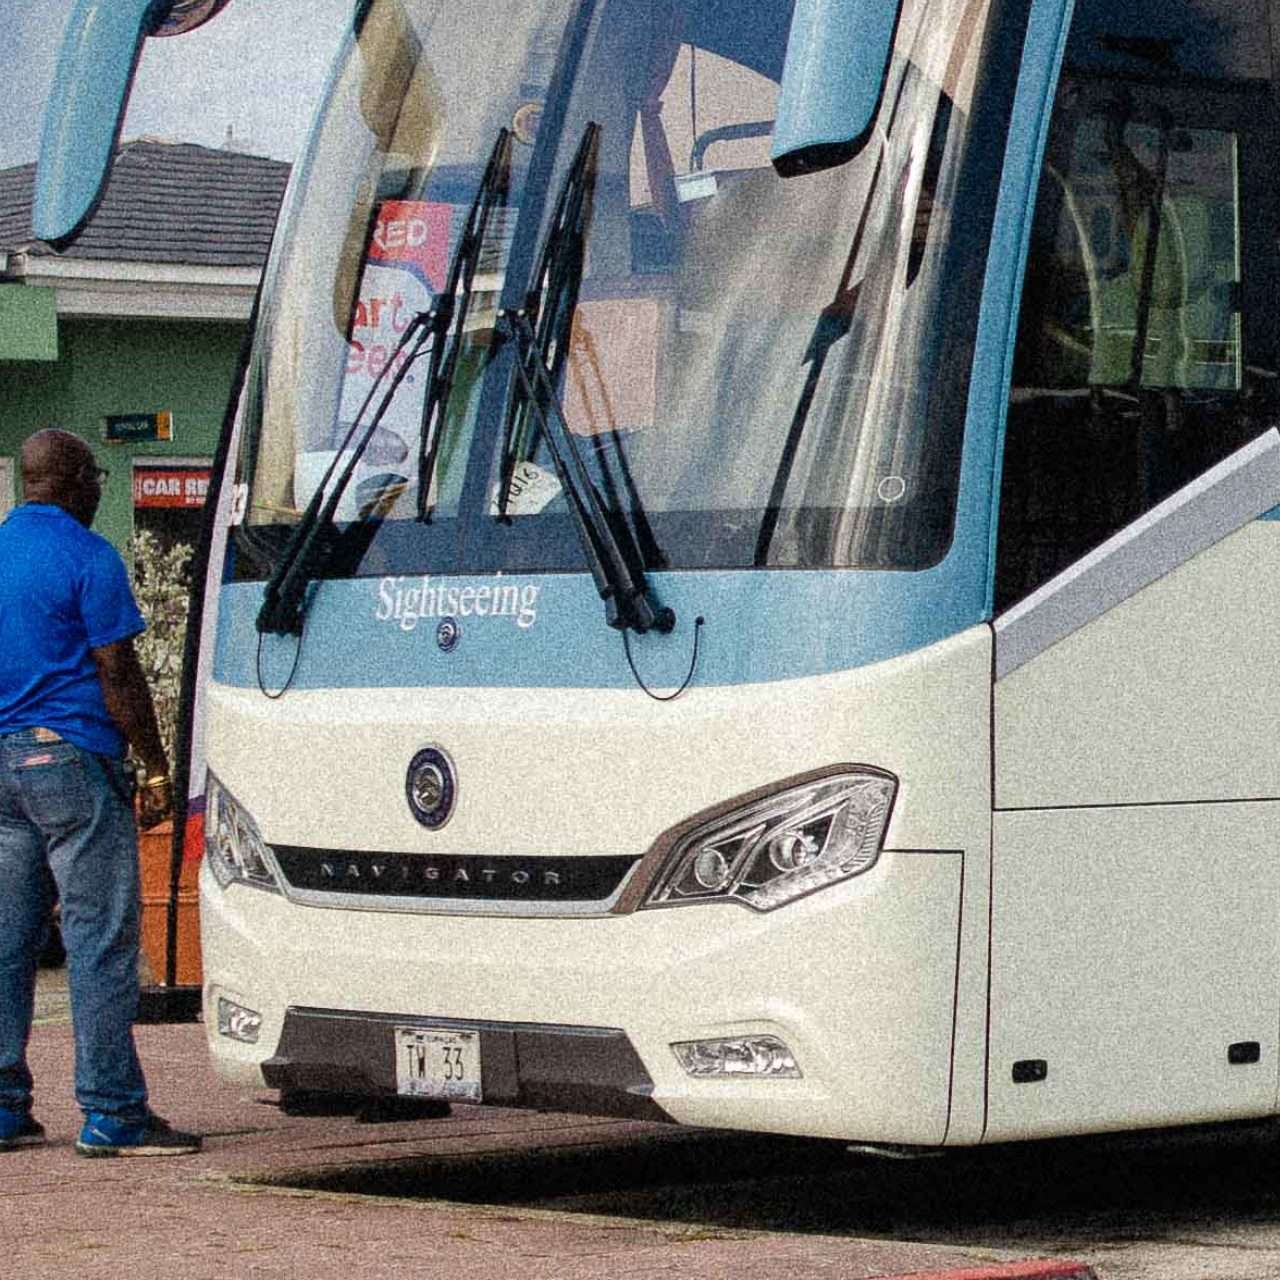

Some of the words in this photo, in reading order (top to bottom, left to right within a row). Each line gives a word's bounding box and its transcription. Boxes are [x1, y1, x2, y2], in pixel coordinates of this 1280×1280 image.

[142, 477, 181, 497] CAR
[375, 571, 540, 631] Sightseeing
[320, 863, 561, 885] NAVIGATOR
[442, 1046, 465, 1081] 33
